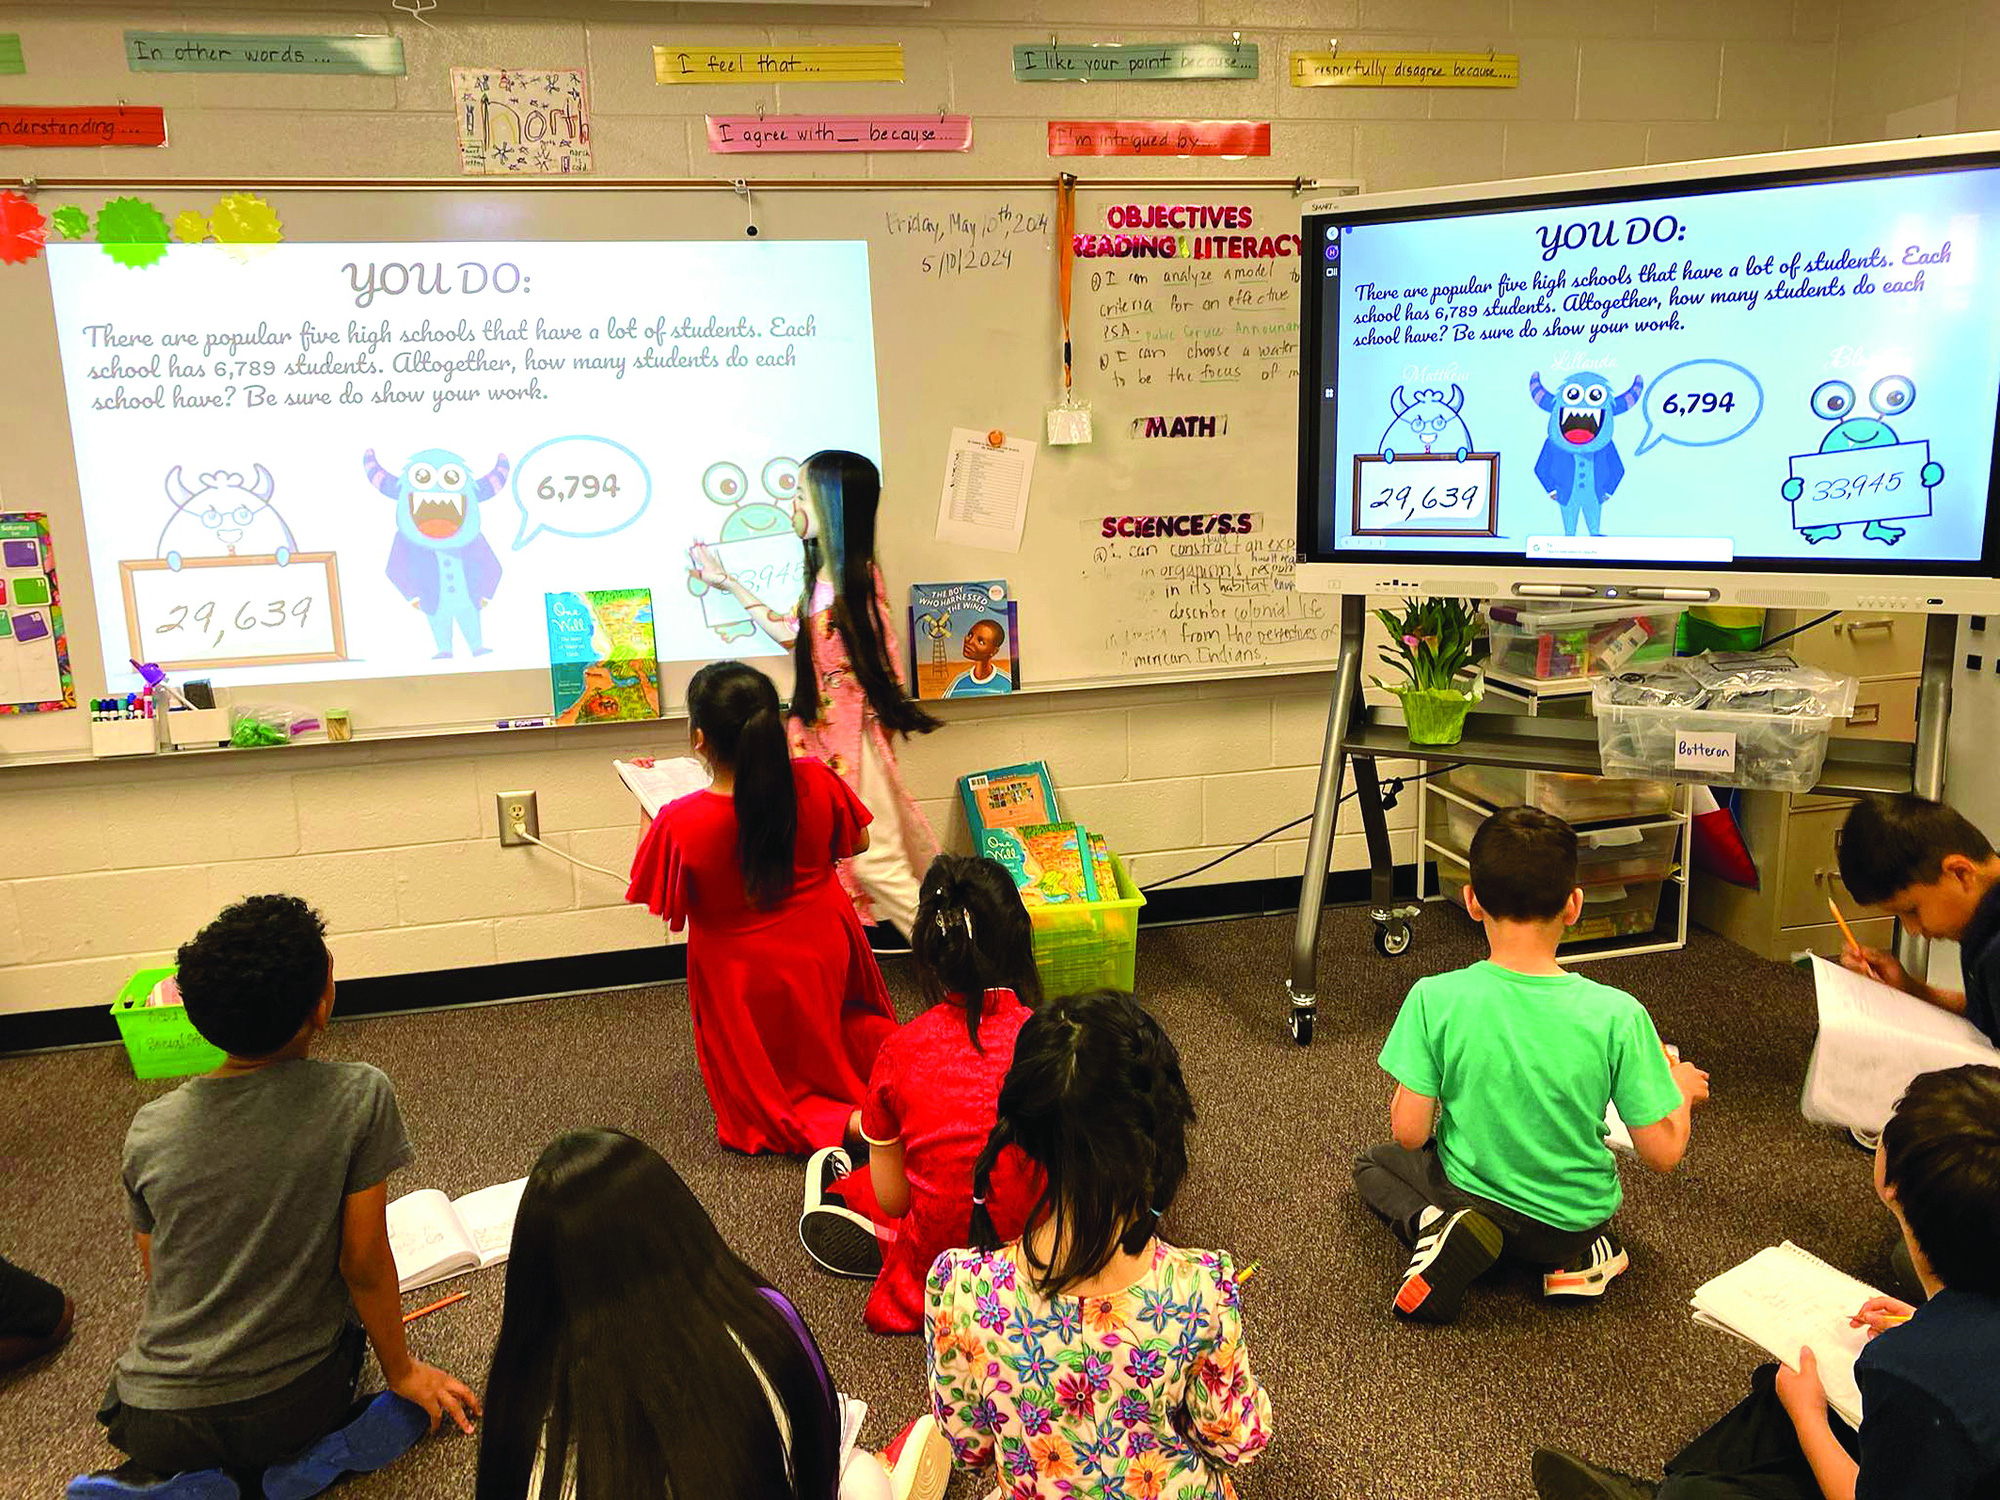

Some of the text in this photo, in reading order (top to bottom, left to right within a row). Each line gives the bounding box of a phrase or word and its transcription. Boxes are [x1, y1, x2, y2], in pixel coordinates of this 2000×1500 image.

[133, 42, 164, 61] In
[174, 42, 231, 62] other
[676, 54, 695, 74] I
[707, 53, 744, 73] feel
[1024, 51, 1037, 69] I
[1045, 51, 1075, 69] like
[1084, 59, 1118, 77] your
[1129, 51, 1172, 75] point
[1297, 59, 1306, 77] I
[1394, 61, 1446, 82] disagree
[719, 125, 734, 143] I
[743, 131, 788, 148] agree
[1100, 130, 1168, 152] intrigued
[950, 212, 976, 247] May
[1108, 205, 1253, 229] OBJECTIVES
[1535, 214, 1687, 262] YOU DO:
[340, 261, 531, 309] YOU DO:
[1163, 265, 1213, 288] analyze
[1234, 261, 1274, 280] model
[1354, 240, 1952, 306] There are popular five high schools that have a lot of students. Each
[1100, 298, 1154, 318] criteria
[1171, 294, 1194, 313] for
[1352, 269, 1926, 325] school has 6,789 students. Altogether, how many students do each
[81, 313, 817, 358] There are popular five high schools that have a lot of students. Each
[1352, 309, 1685, 347] school have? Be sure do show your work.
[1187, 342, 1230, 359] choose
[86, 343, 796, 384] school has 6,789 students. Altogether, how many students do each
[1200, 366, 1242, 381] focus
[90, 376, 548, 414] school have? Be sure do show your work.
[1663, 392, 1736, 417] 6,794
[1145, 416, 1216, 438] MATH
[536, 473, 621, 503] 6,794
[1813, 471, 1902, 502] 33,945
[1370, 485, 1480, 521] 29,639
[1102, 513, 1253, 538] SCIENCE/S.S
[919, 593, 988, 607] WHO HARNESSED
[931, 586, 963, 599] THE BOY
[963, 601, 985, 613] WIND
[155, 596, 314, 648] 29,639
[1181, 623, 1221, 643] from
[1227, 623, 1251, 643] the
[1678, 740, 1730, 758] Botteron
